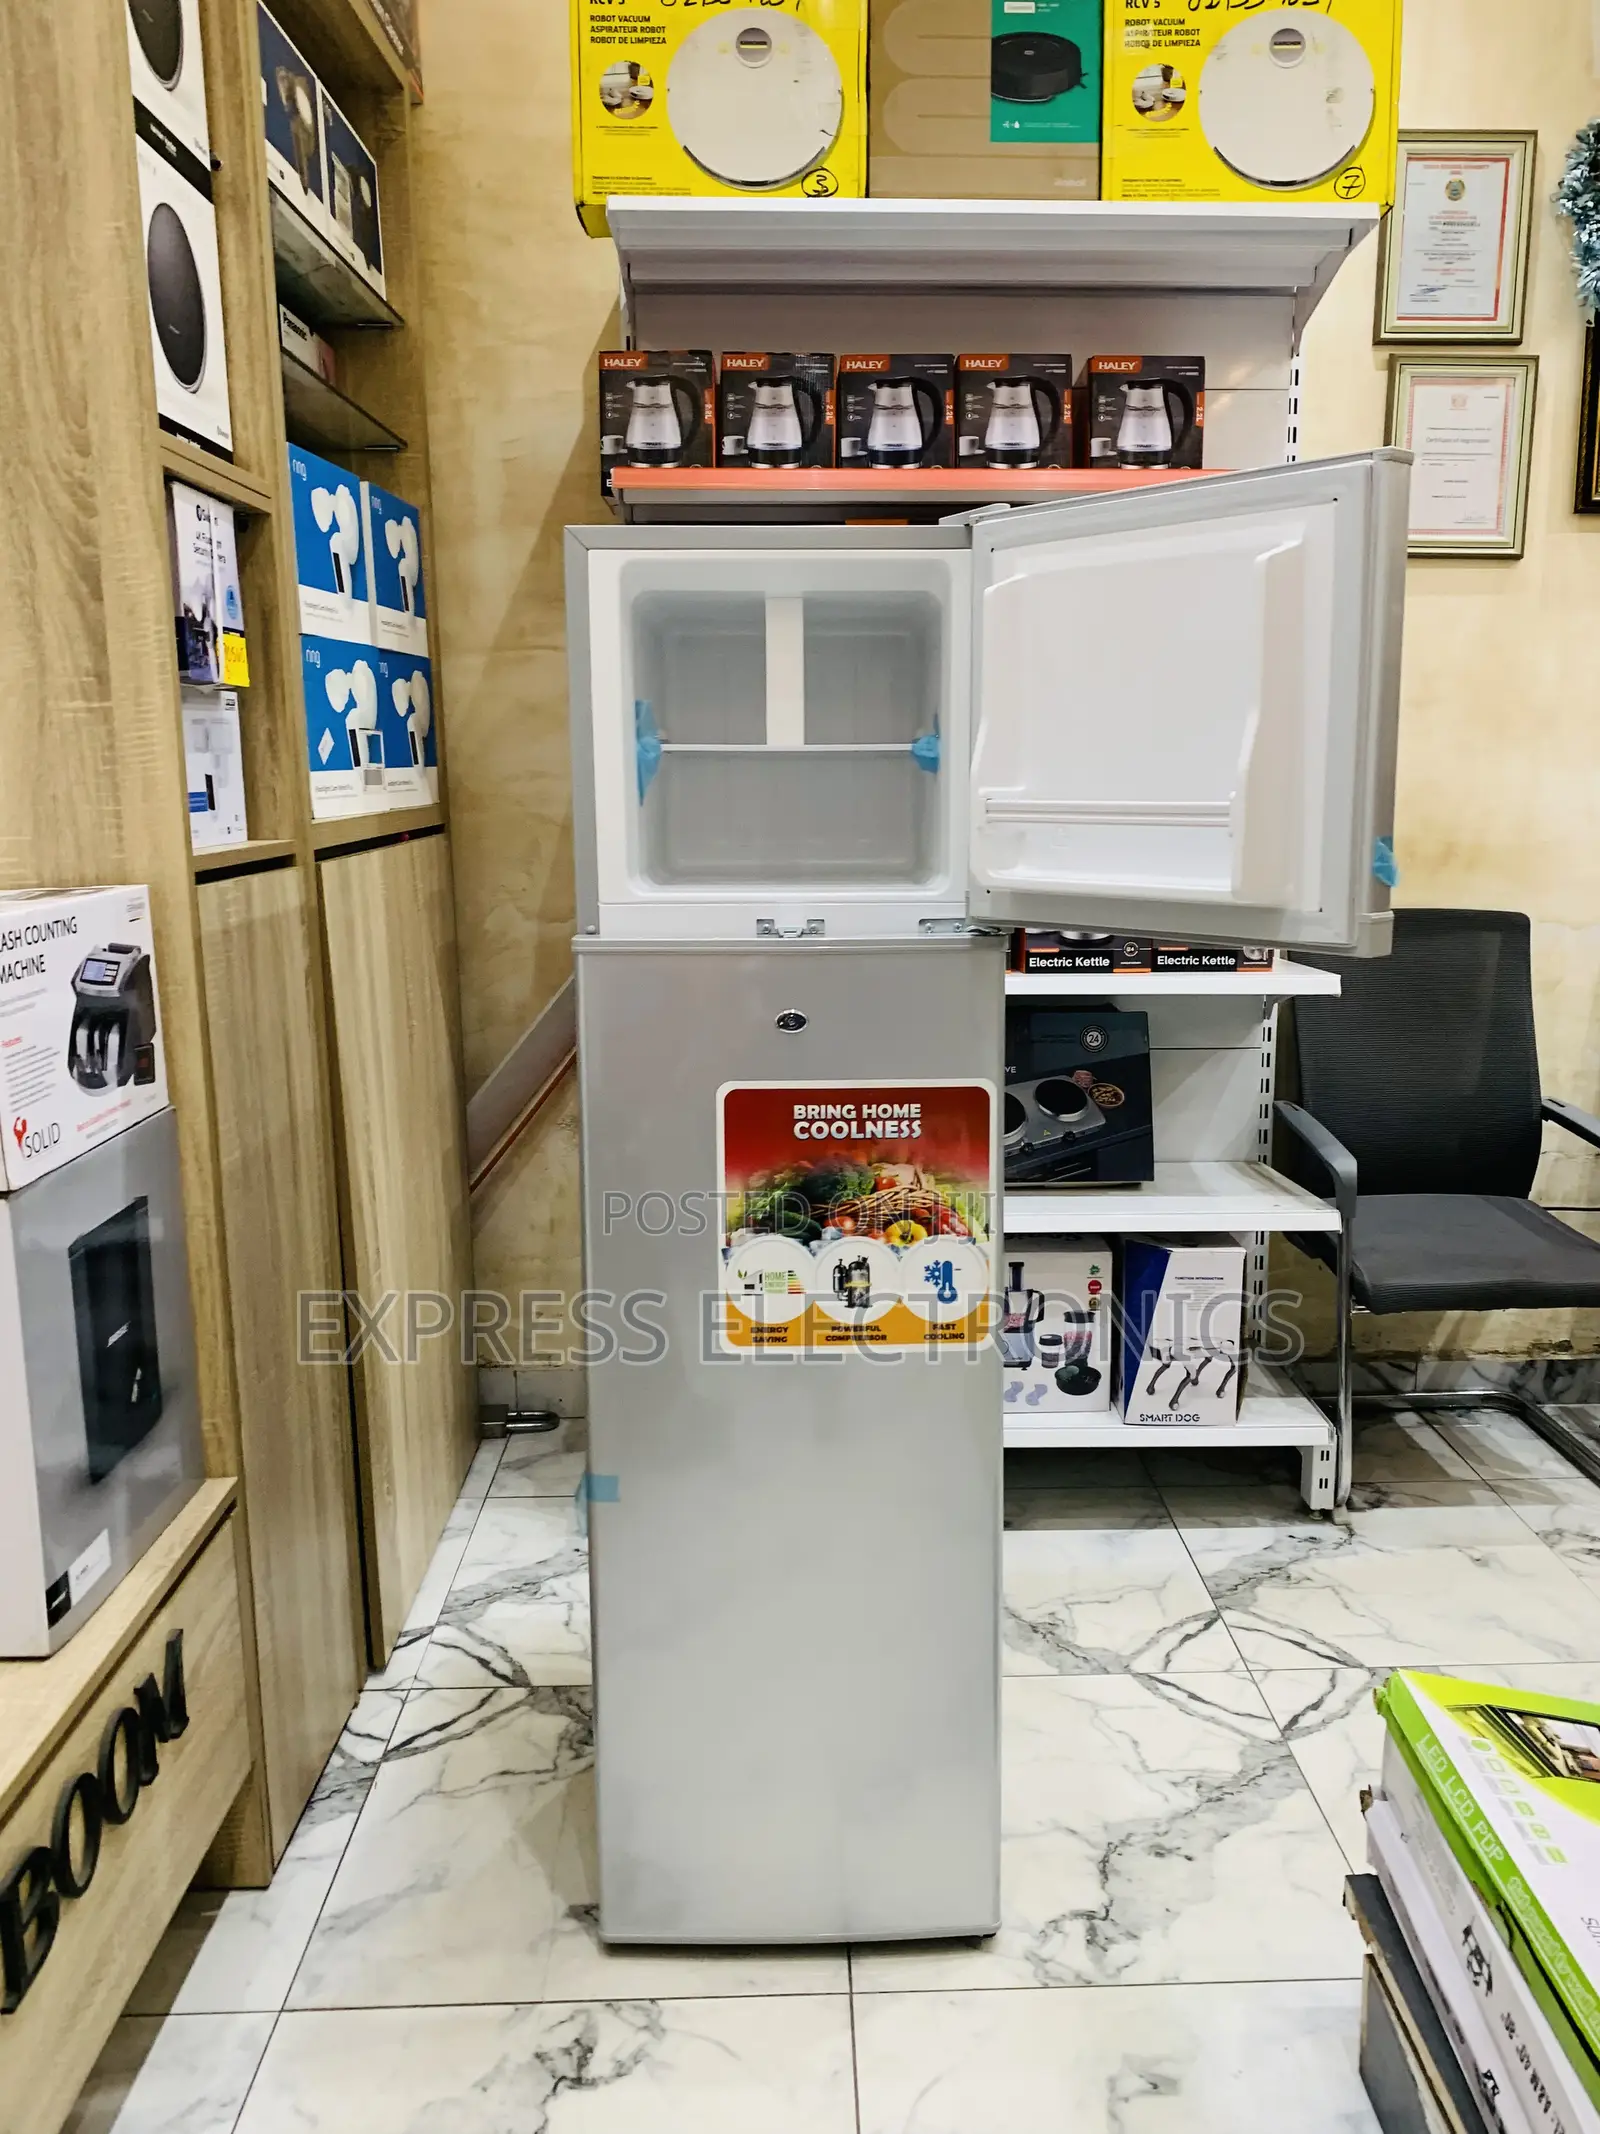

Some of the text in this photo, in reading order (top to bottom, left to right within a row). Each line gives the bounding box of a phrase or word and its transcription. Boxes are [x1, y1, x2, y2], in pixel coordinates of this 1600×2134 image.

[618, 15, 651, 23] VACUUM
[1153, 18, 1186, 26] VACUUM
[1174, 28, 1201, 36] ROBOT
[590, 36, 617, 44] ROBOT
[1164, 39, 1201, 47] LIMPIEZA
[604, 358, 641, 367] HALEY
[726, 358, 765, 368] HALEY
[846, 360, 884, 369] HALEY
[965, 359, 1003, 368] HALEY
[1098, 361, 1136, 370] HALEY
[1063, 403, 1072, 420] 2.2L
[1195, 406, 1204, 422] 2.2L
[305, 646, 321, 668] ring
[0, 916, 78, 952] ASH COUNTING
[1029, 956, 1110, 968] Electric Kettle
[1157, 955, 1236, 966] Electric Kettle
[0, 954, 46, 984] MACHINE
[1088, 1034, 1100, 1044] 24
[793, 1103, 922, 1121] BRING HOME
[793, 1120, 923, 1141] COOLNESS
[25, 1122, 61, 1159] SOLID
[764, 1271, 787, 1281] HOME
[750, 1326, 789, 1334] ENERGY
[831, 1325, 882, 1333] POWERFUL
[932, 1323, 957, 1331] FAST
[825, 1334, 887, 1342] COMPRESSOR
[924, 1332, 965, 1340] COOLING
[1139, 1413, 1201, 1422] SMART DOG
[1418, 1734, 1449, 1773] LED
[1445, 1775, 1475, 1817] LCD
